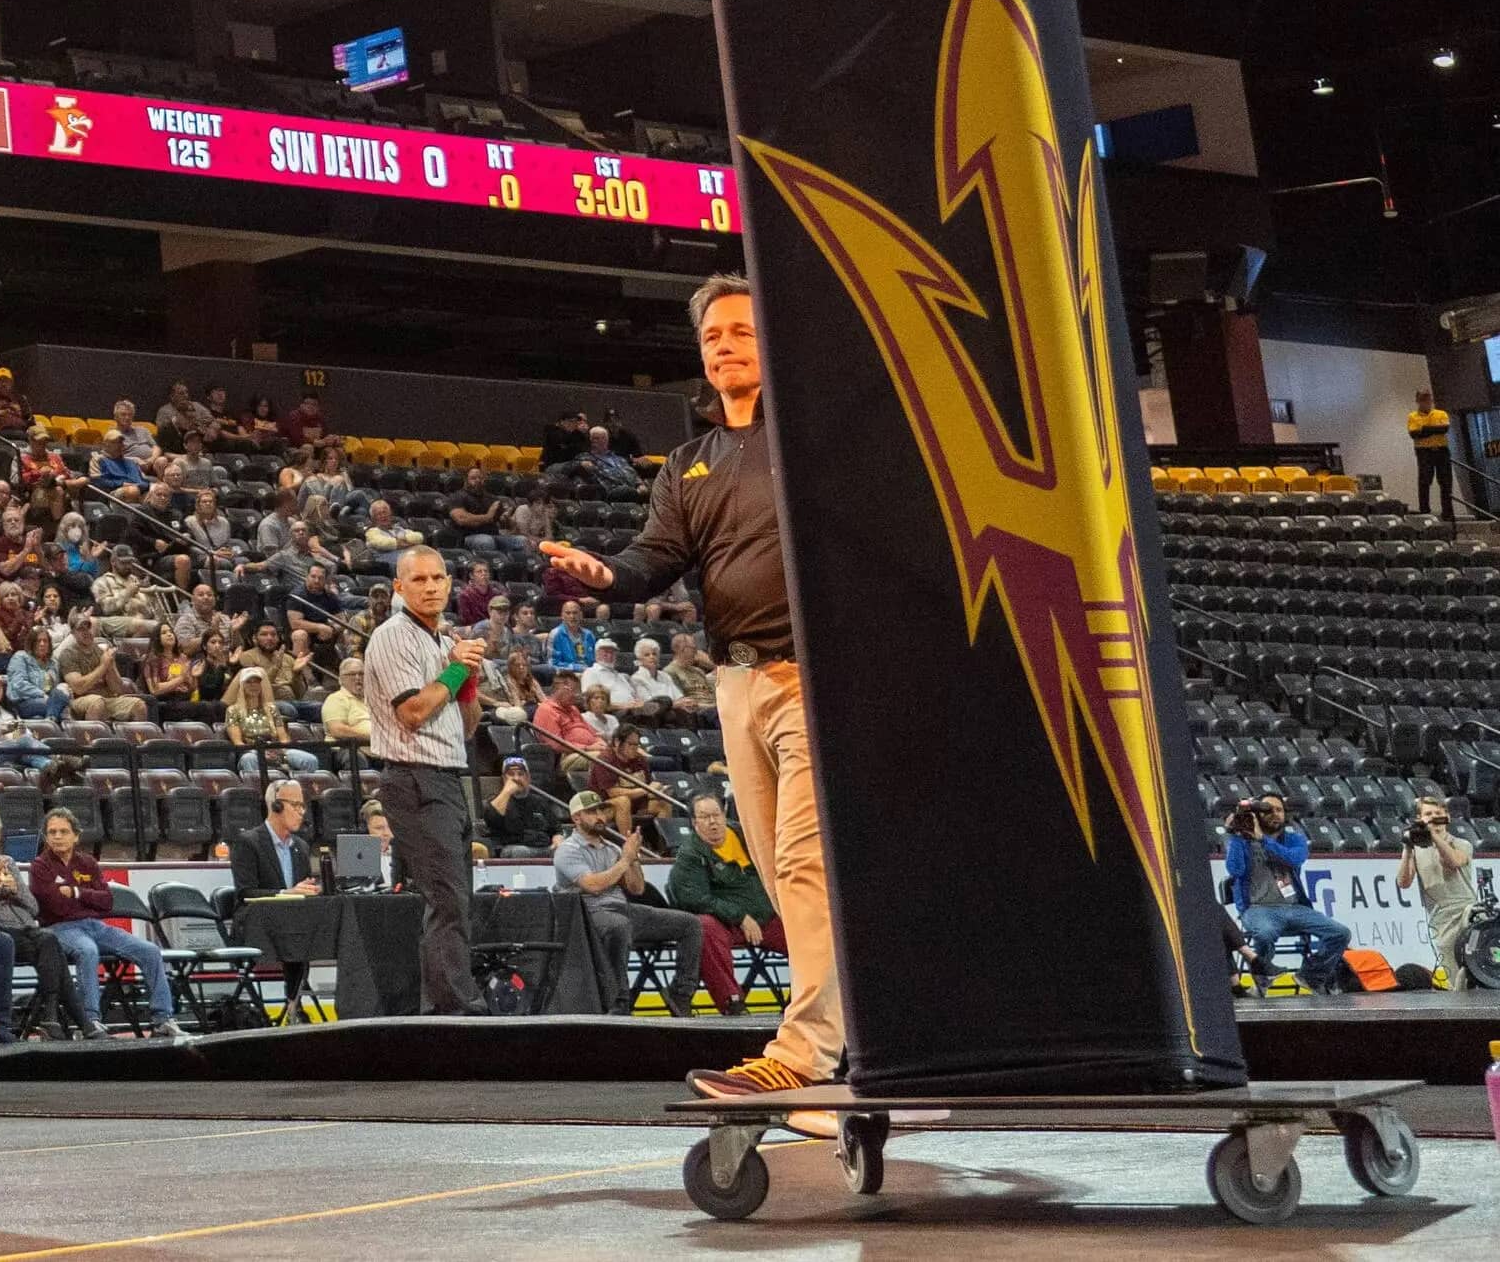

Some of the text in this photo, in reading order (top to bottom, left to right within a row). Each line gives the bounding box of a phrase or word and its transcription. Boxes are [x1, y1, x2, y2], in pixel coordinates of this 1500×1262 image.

[147, 106, 223, 138] WEIGHT
[168, 138, 211, 169] 125
[269, 127, 448, 188] SUN DEVILS 0
[486, 143, 514, 170] RT
[593, 156, 621, 178] 1ST
[698, 169, 725, 196] RT
[573, 174, 649, 221] 3:00
[303, 369, 325, 387] 112
[1355, 920, 1403, 946] LAW
